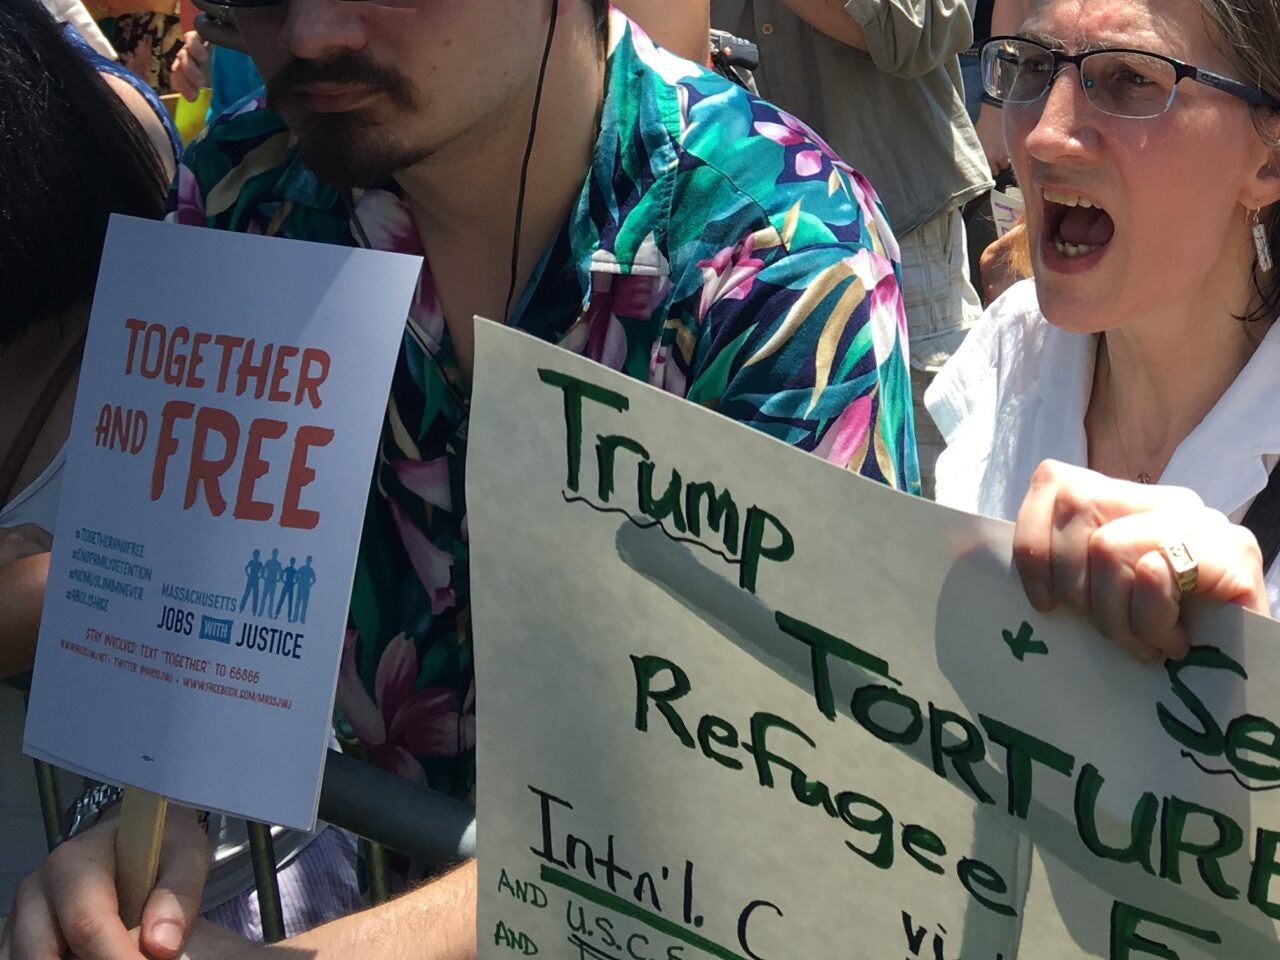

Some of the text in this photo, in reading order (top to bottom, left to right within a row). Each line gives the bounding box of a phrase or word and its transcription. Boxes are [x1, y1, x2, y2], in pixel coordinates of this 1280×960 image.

[125, 318, 331, 409] TOGETHER
[95, 400, 335, 530] AND FREE
[538, 368, 795, 593] Trump
[161, 582, 237, 613] MASSACHUSETTS
[85, 627, 103, 644] STAY
[141, 644, 159, 660] TEXT
[161, 649, 212, 674] "TOGETHER"
[215, 661, 227, 677] TO
[229, 666, 260, 685] 66866
[157, 605, 304, 660] JOBS WITH JUSTICE
[630, 654, 1018, 917] Refugee
[498, 868, 549, 908] AND
[494, 920, 539, 956] AND
